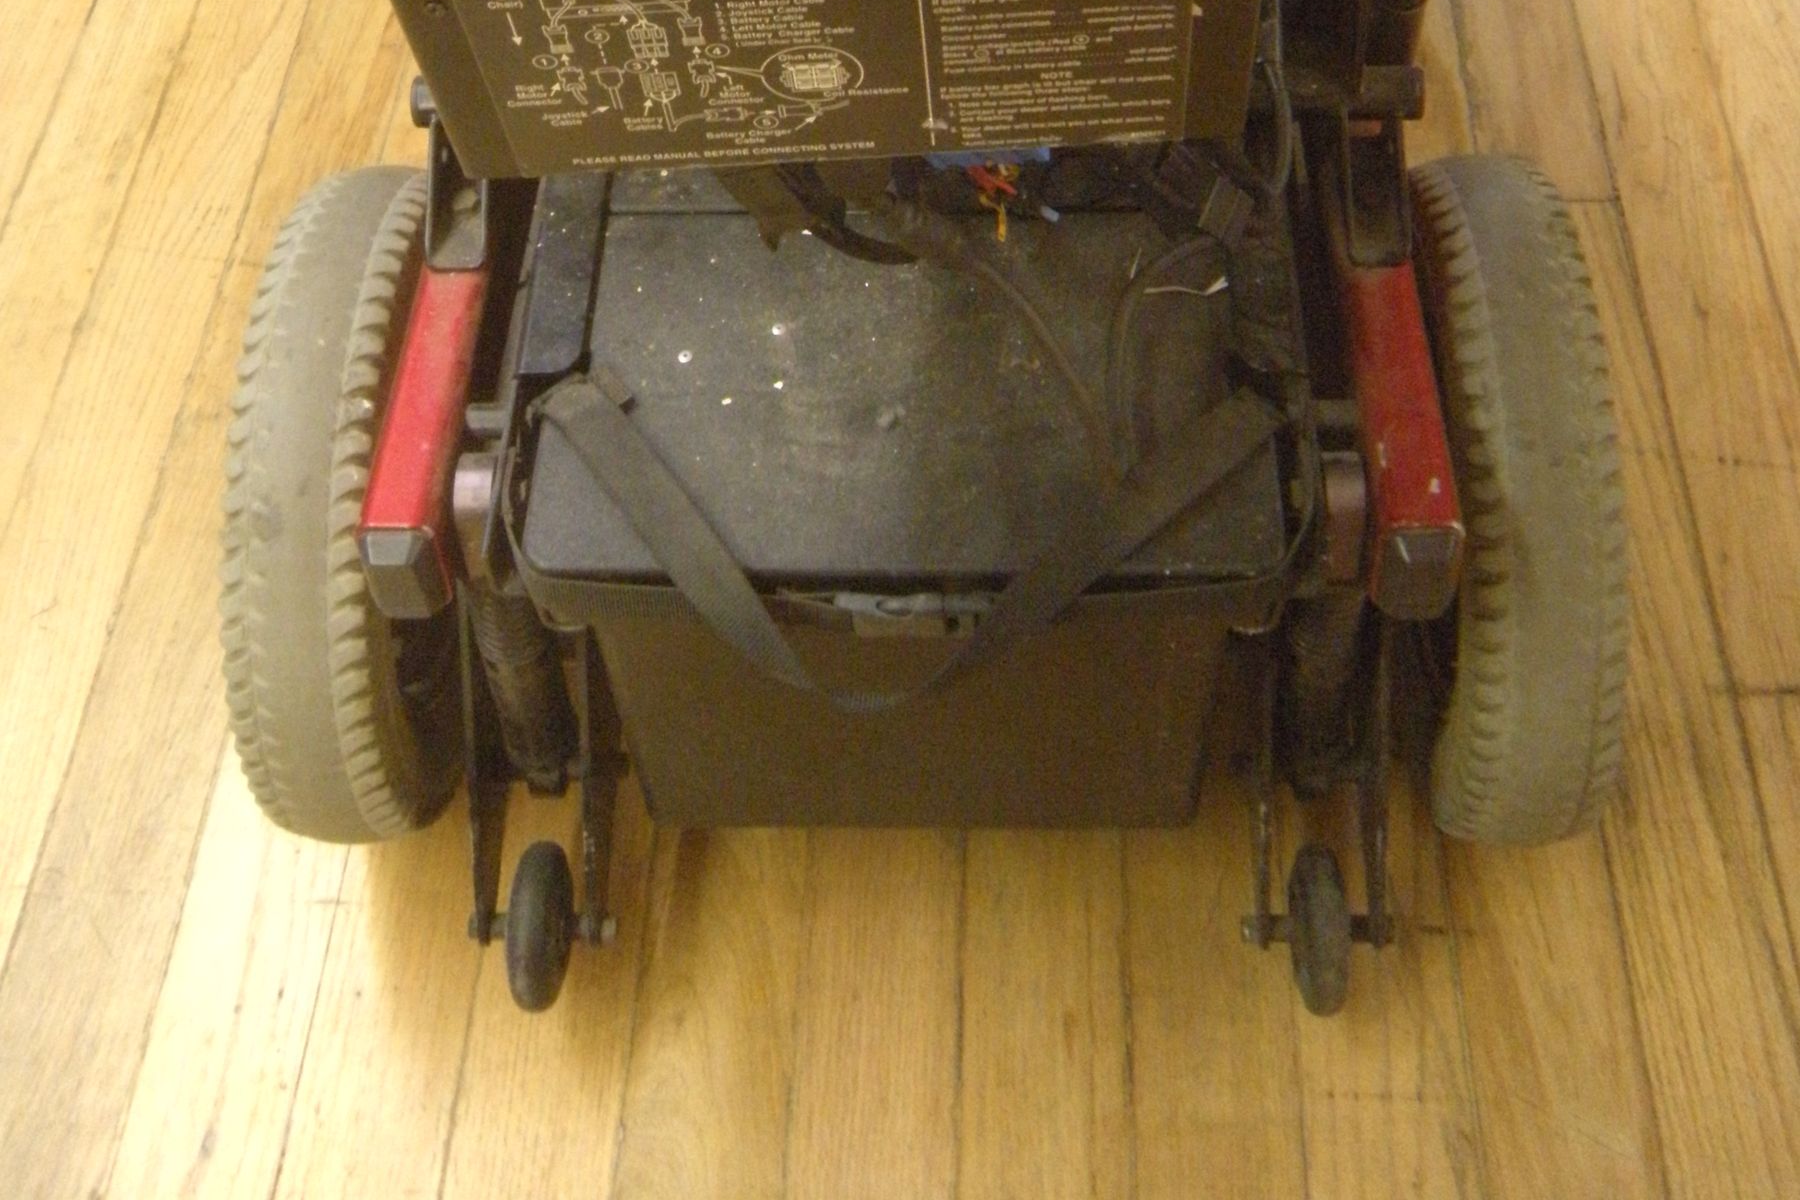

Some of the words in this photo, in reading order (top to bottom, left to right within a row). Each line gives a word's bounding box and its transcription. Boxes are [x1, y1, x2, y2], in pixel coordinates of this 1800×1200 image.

[487, 0, 524, 10] Chair)
[727, 1, 755, 10] Right
[759, 0, 790, 7] Motor
[777, 6, 808, 14] Cable
[730, 16, 770, 25] Battery
[773, 14, 804, 22] Cable
[733, 32, 773, 40] Battery
[778, 29, 821, 38] Charger
[808, 52, 838, 60] Meter
[1040, 71, 1072, 80] NOTE
[572, 157, 617, 165] PLEASE
[620, 154, 650, 162] READ
[653, 152, 700, 160] MANUAL
[704, 148, 750, 158] BEFORE
[752, 144, 826, 154] CONNECTING
[830, 141, 875, 149] SYSTEM
